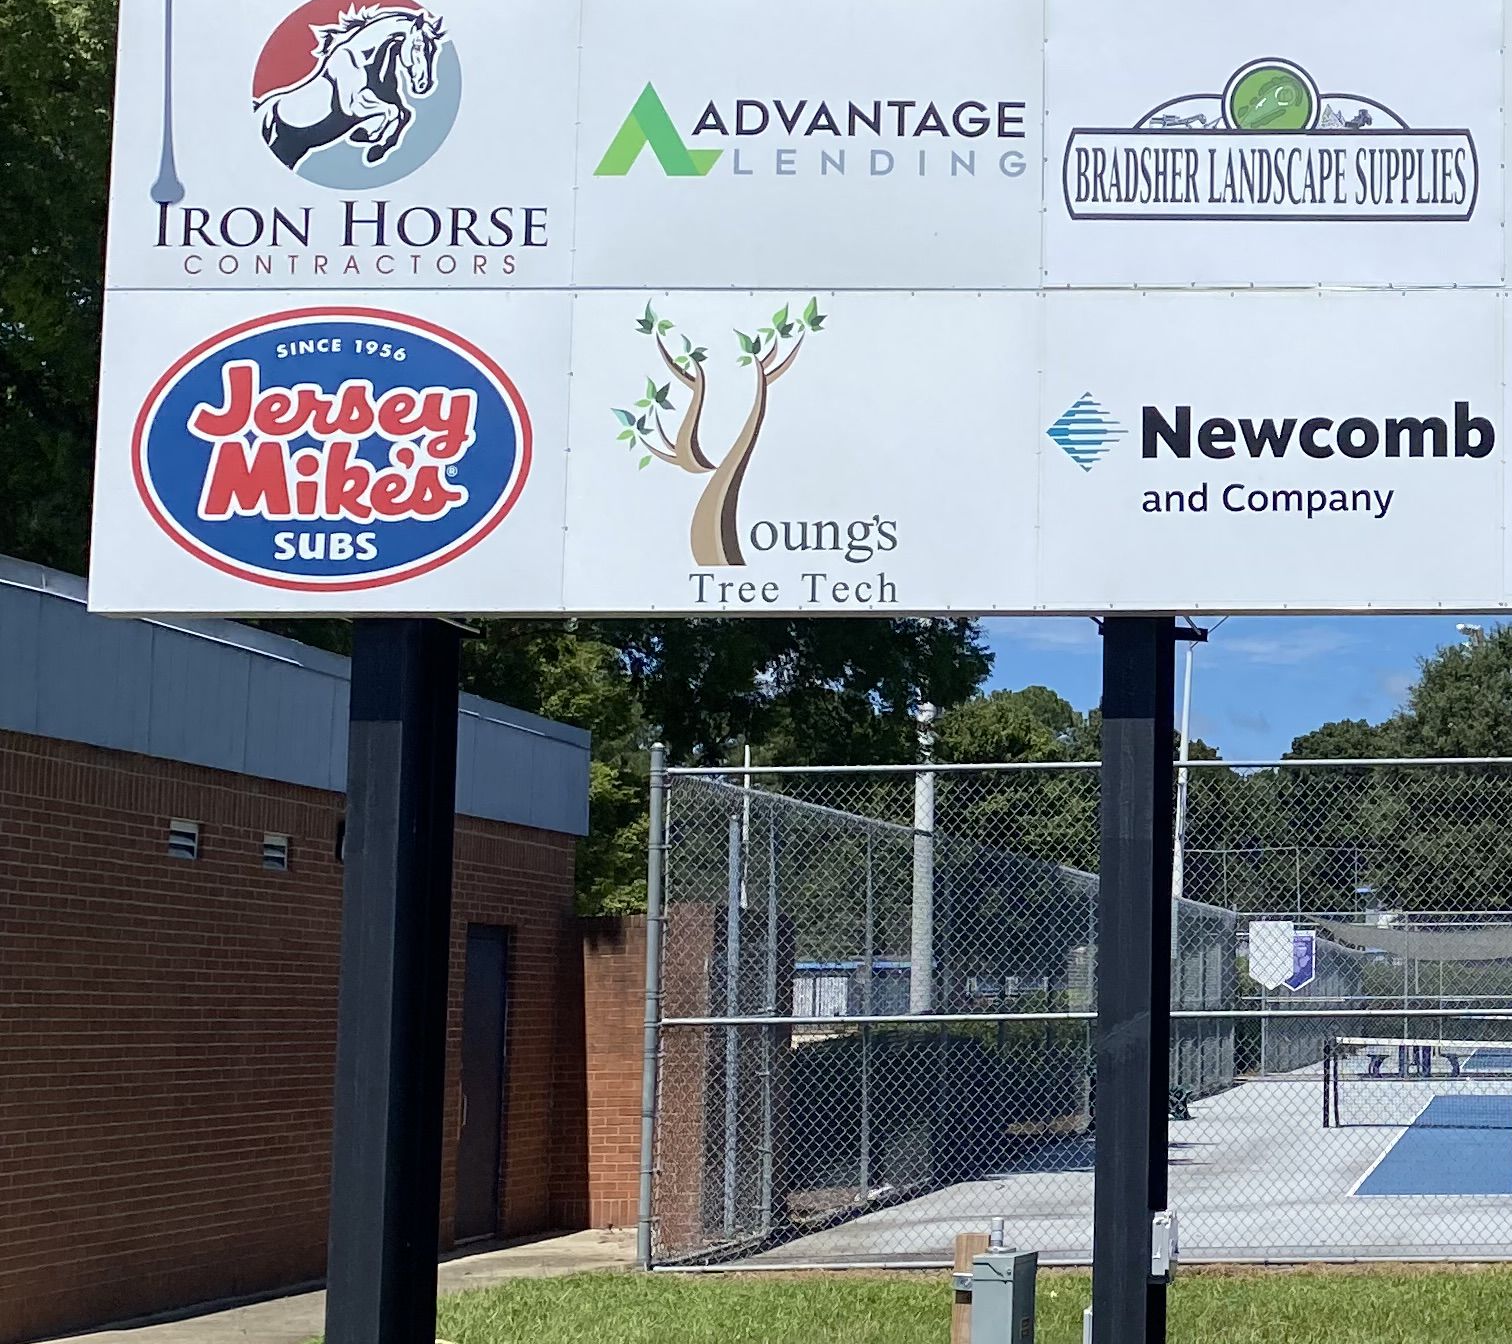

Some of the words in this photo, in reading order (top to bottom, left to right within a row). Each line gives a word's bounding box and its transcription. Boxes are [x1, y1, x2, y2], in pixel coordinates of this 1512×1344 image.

[691, 99, 1026, 138] ADVANTAGE
[733, 148, 1027, 177] LENDING
[1075, 147, 1200, 203] BRADSHER
[1208, 147, 1346, 204] LANDSCAPE
[1355, 147, 1466, 205] SUPPLIES
[153, 201, 313, 247] IRON
[339, 200, 548, 247] HORSE
[184, 255, 516, 275] CONTRACTORS
[276, 338, 342, 359] SINCE
[355, 339, 407, 362] 1956
[192, 365, 471, 452] Jersey
[1141, 401, 1496, 459] Newcomb
[204, 440, 463, 520] Mike's
[1142, 482, 1208, 513] and
[1222, 484, 1395, 519] Company
[274, 531, 378, 561] SUBS
[689, 573, 780, 603] Tree
[801, 573, 899, 603] Tech
